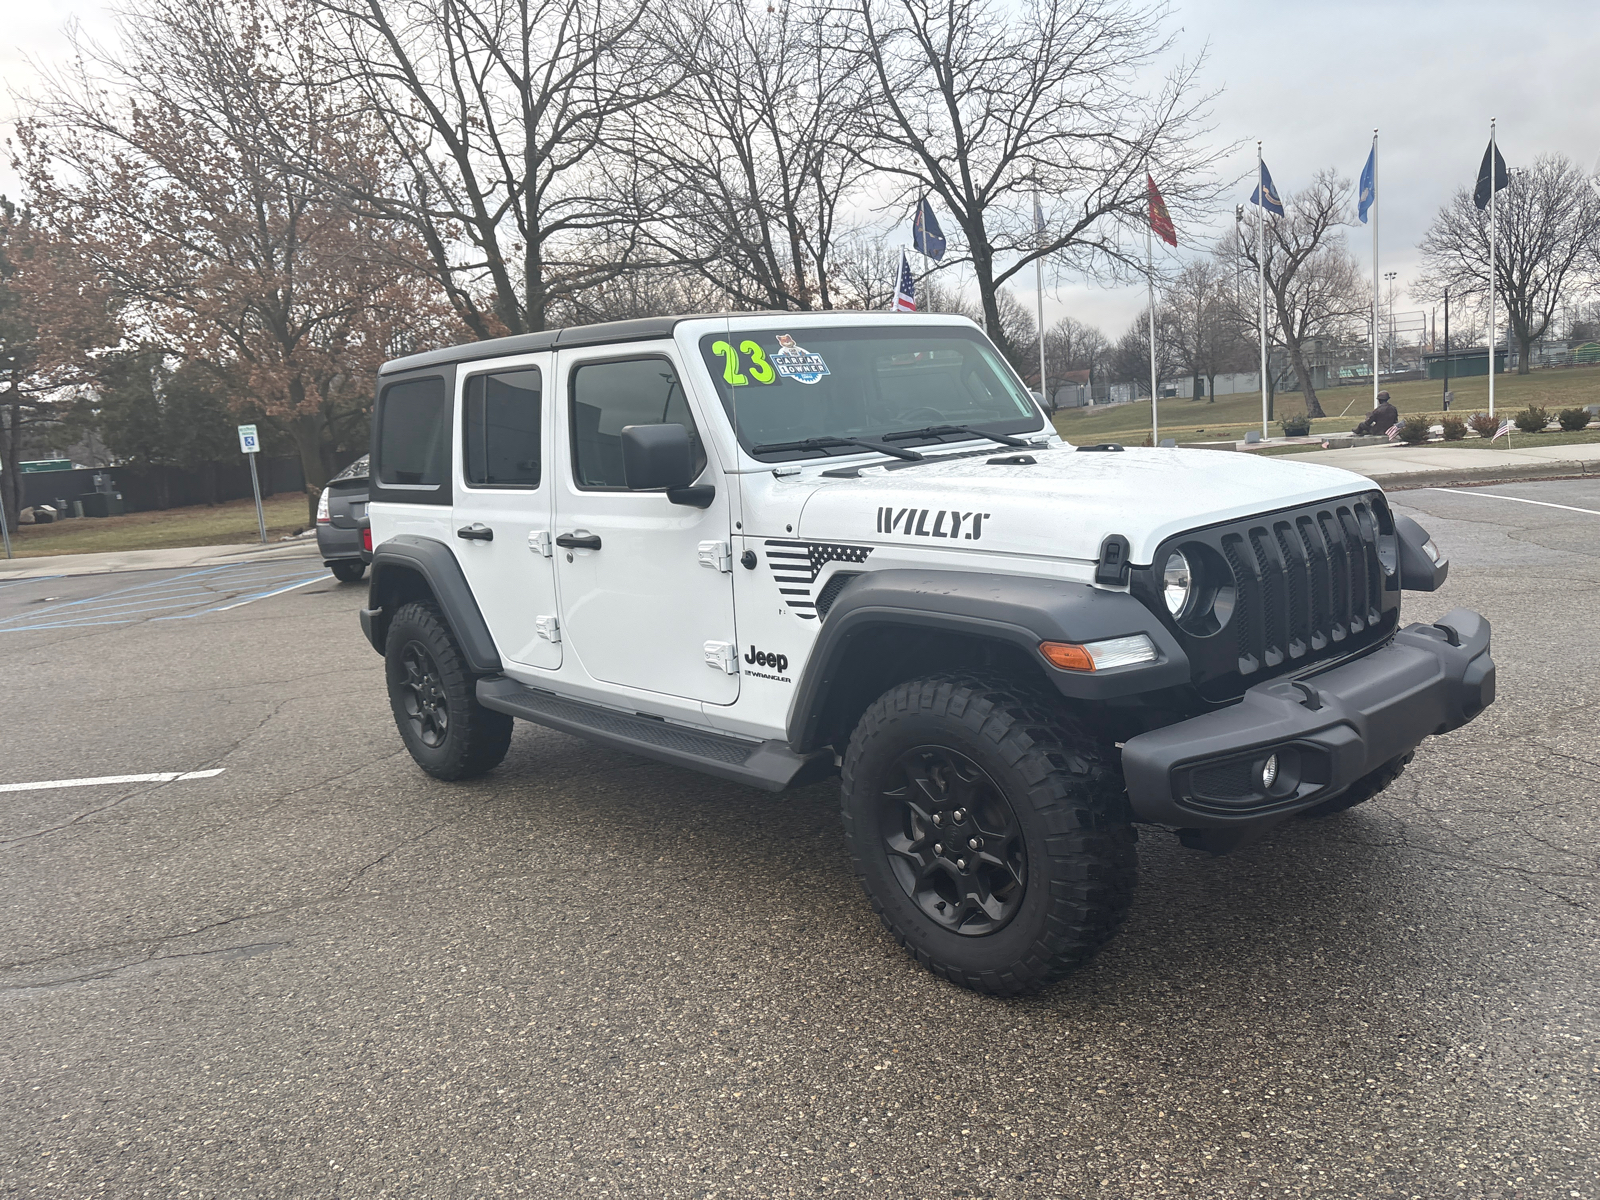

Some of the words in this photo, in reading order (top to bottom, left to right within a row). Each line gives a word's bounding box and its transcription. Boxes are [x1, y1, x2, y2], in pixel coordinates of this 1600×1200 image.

[712, 340, 776, 386] 23
[776, 356, 823, 364] CARFAX
[789, 365, 825, 373] OWNER
[877, 507, 991, 540] WILLYS
[744, 645, 788, 673] Jeep
[751, 671, 791, 683] WRANGLER
